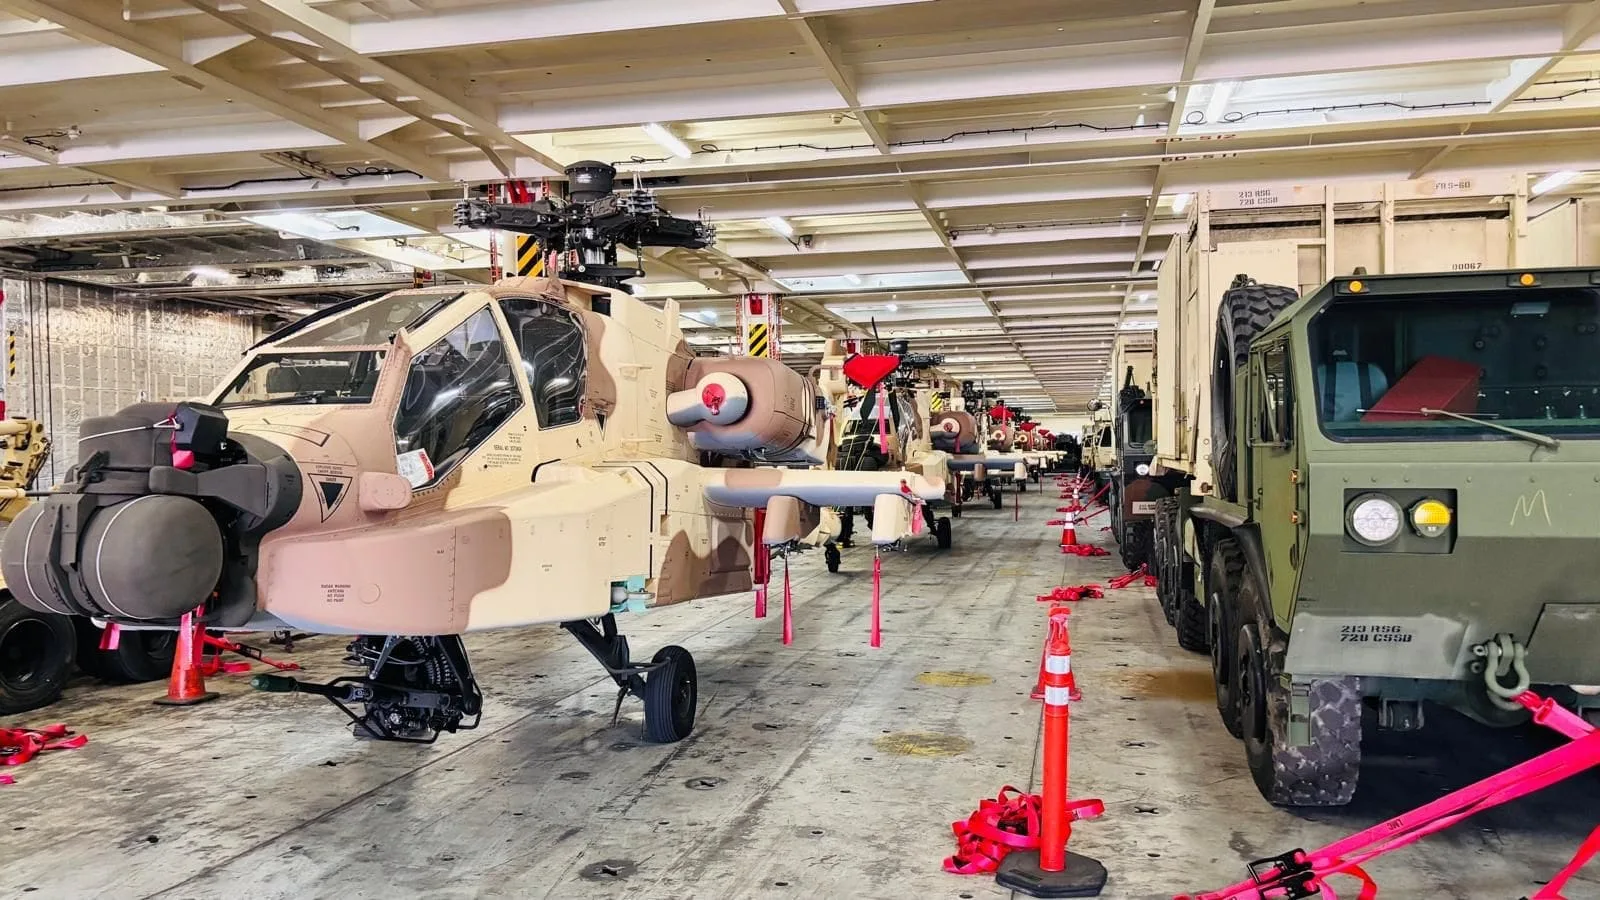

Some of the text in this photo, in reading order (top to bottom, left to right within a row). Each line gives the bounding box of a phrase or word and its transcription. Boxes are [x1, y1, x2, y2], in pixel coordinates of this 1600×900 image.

[1510, 488, 1552, 527] M
[1340, 624, 1401, 633] 213 RSG
